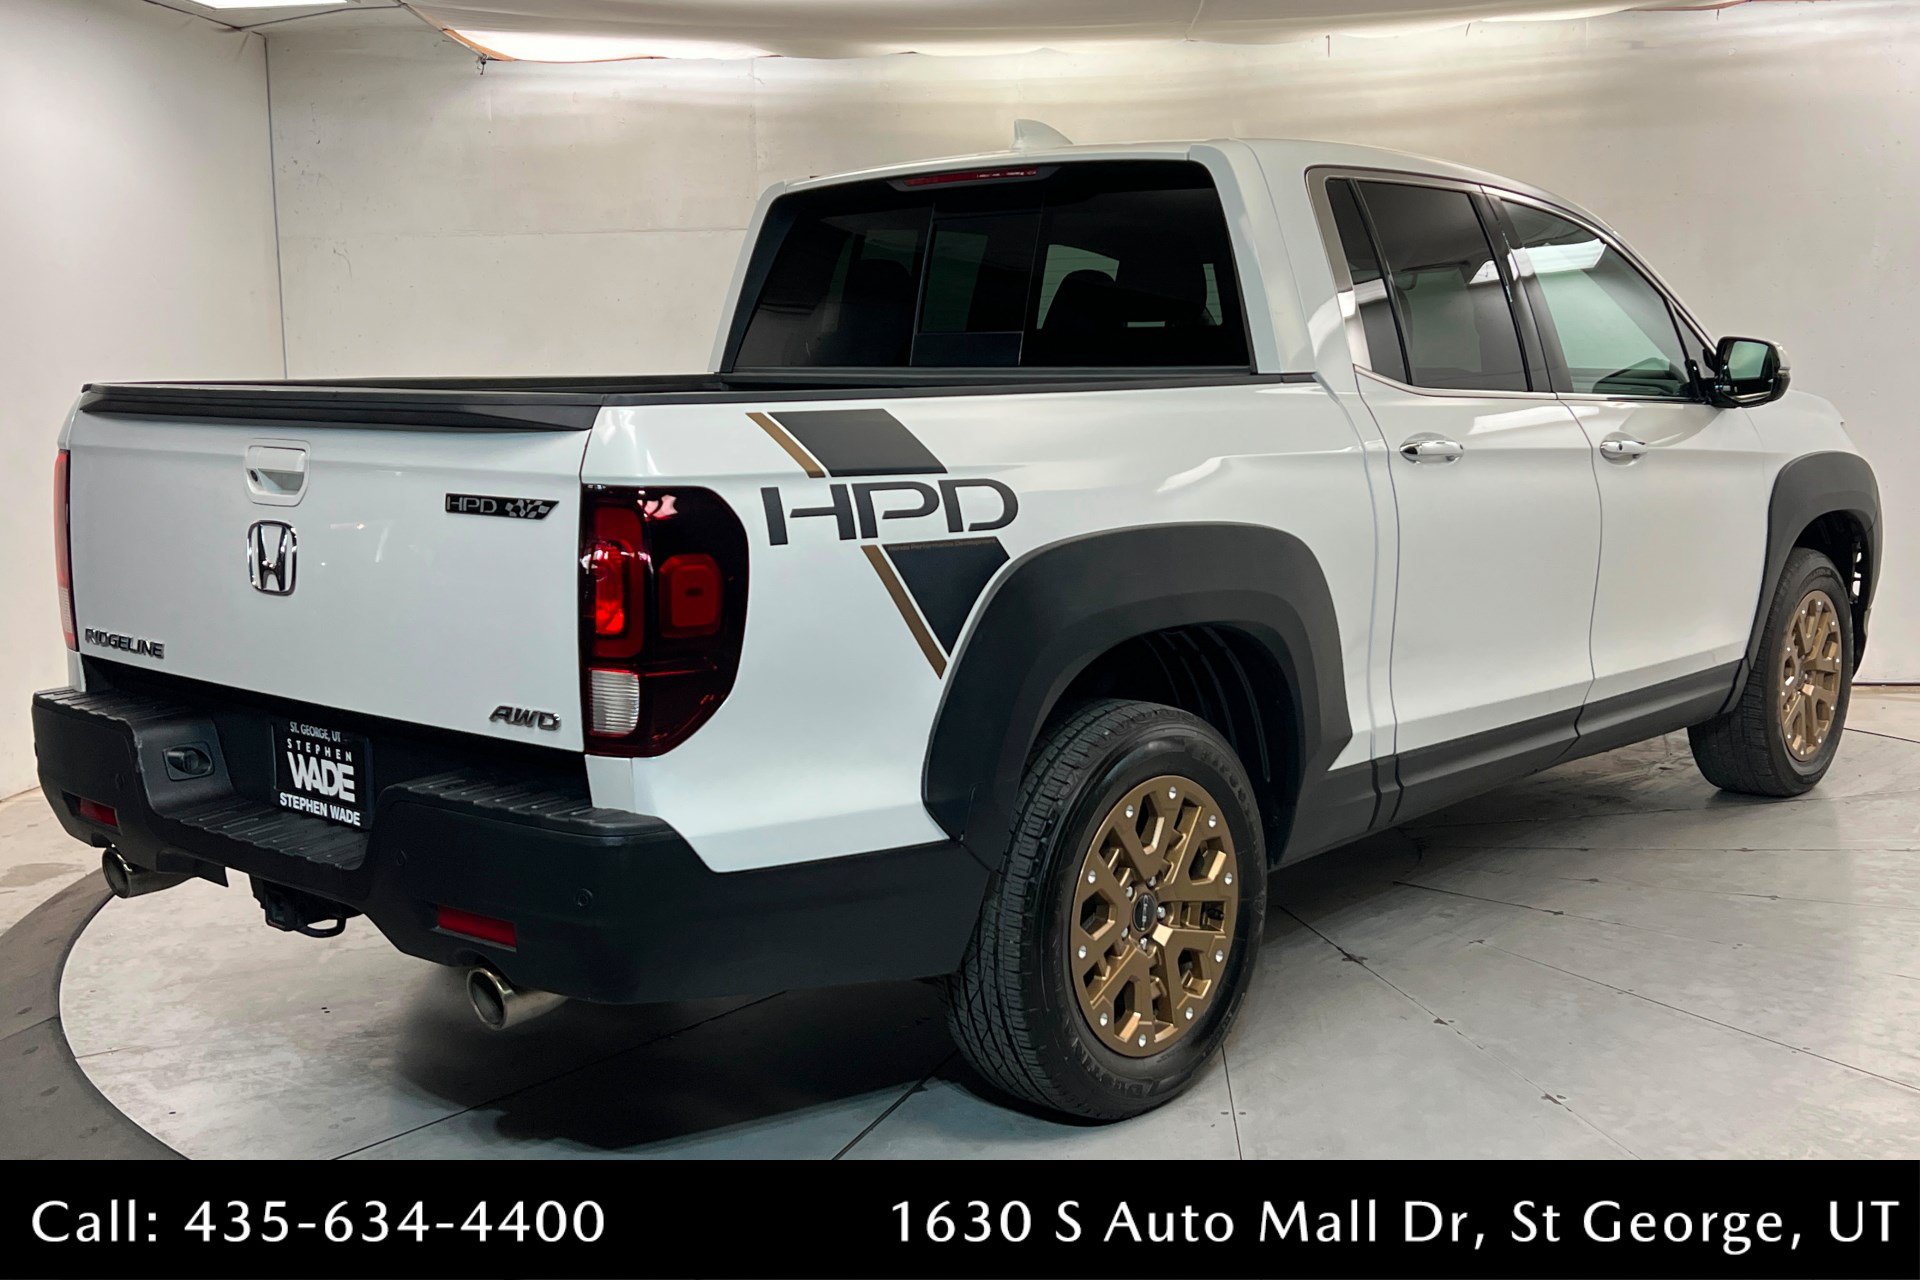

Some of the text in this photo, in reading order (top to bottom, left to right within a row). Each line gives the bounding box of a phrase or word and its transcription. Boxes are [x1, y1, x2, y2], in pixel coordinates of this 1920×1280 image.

[446, 496, 498, 513] HPD
[761, 478, 1019, 546] HPD
[85, 627, 165, 659] RIDGELINE
[300, 723, 331, 742] GEORGE,
[489, 705, 561, 731] AWD
[286, 738, 352, 762] STEPHEN
[287, 751, 356, 803] WADE
[280, 792, 361, 826] STEPHEN WADE
